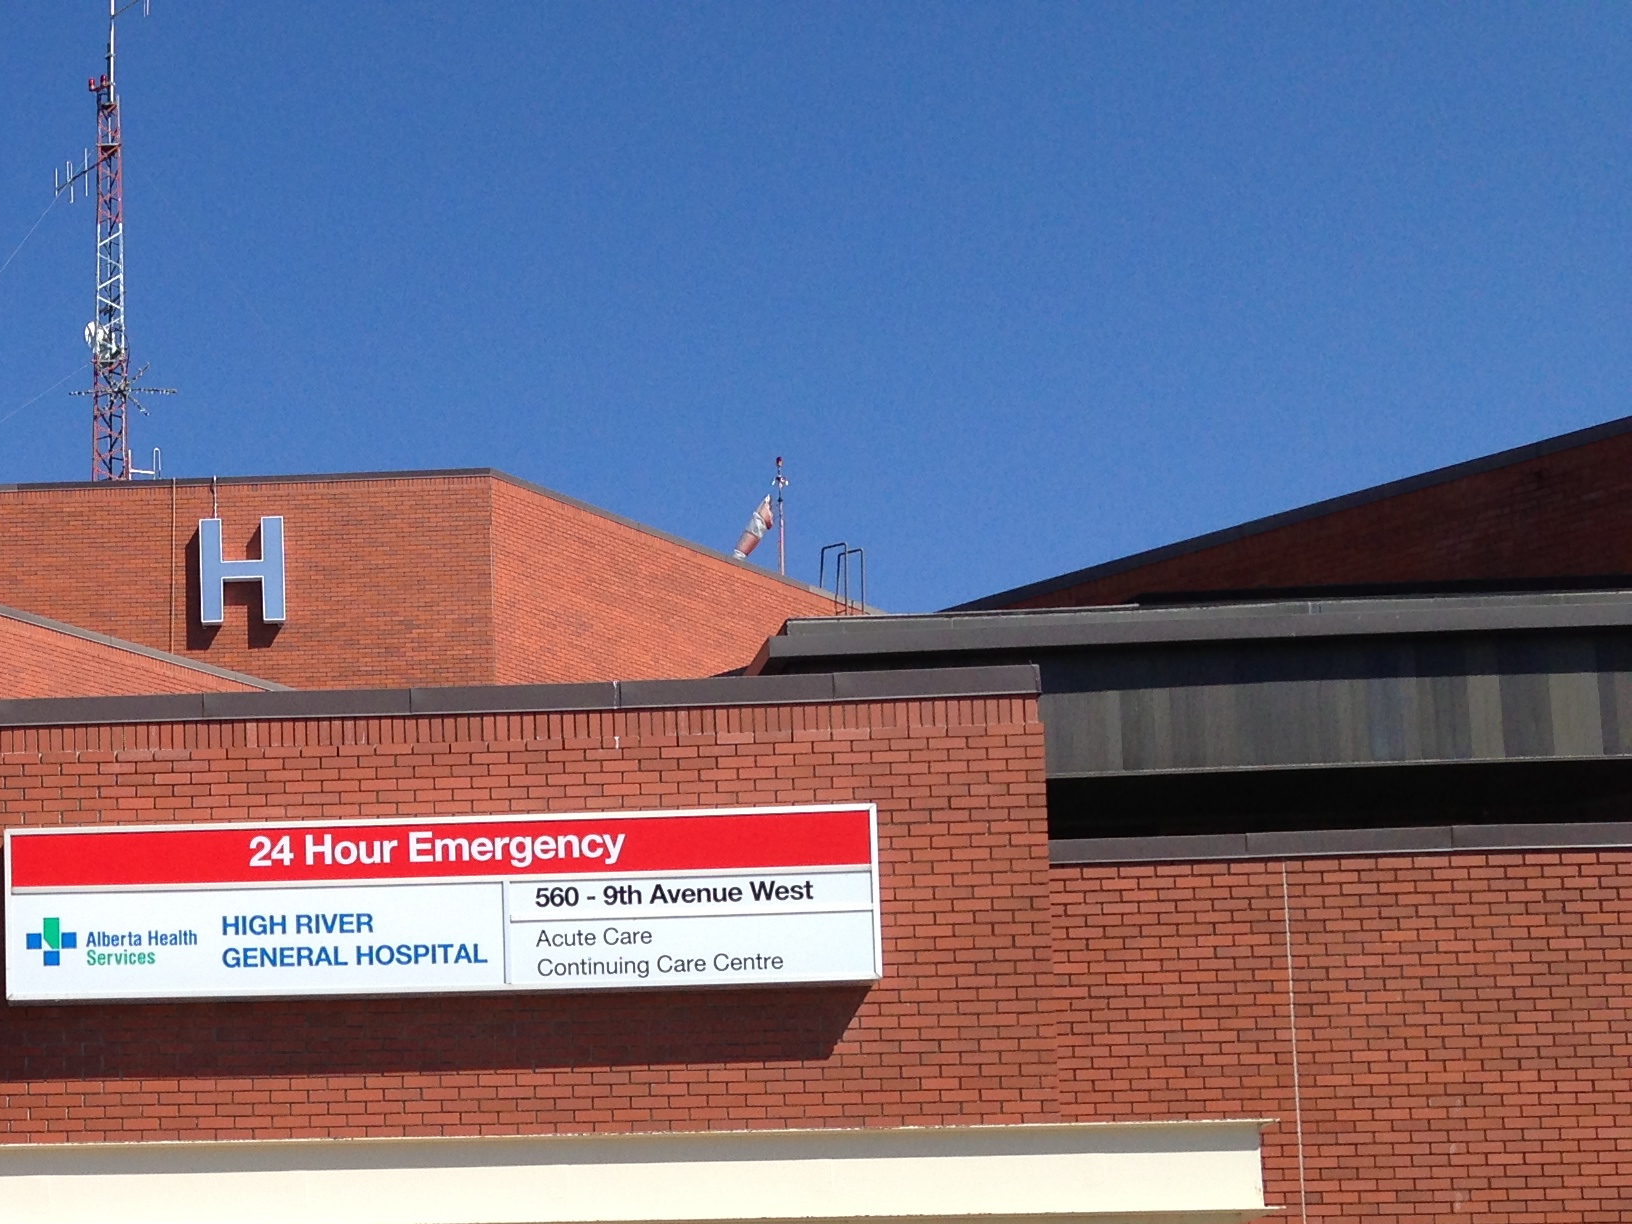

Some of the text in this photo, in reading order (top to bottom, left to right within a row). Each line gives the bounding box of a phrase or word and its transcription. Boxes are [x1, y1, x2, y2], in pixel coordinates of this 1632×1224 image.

[199, 516, 287, 626] H
[249, 831, 626, 868] 24 Hour Emergency
[535, 886, 580, 908] 560
[603, 885, 643, 906] 9th
[649, 883, 743, 905] Avenue
[749, 880, 814, 902] West
[222, 912, 374, 936] HIGH RIVER
[85, 929, 198, 948] Alberta Health
[536, 927, 653, 948] Acute Care
[86, 949, 156, 966] Services
[222, 943, 488, 968] GENERAL HOSPITAL
[537, 953, 784, 978] Continuing Care Centre
